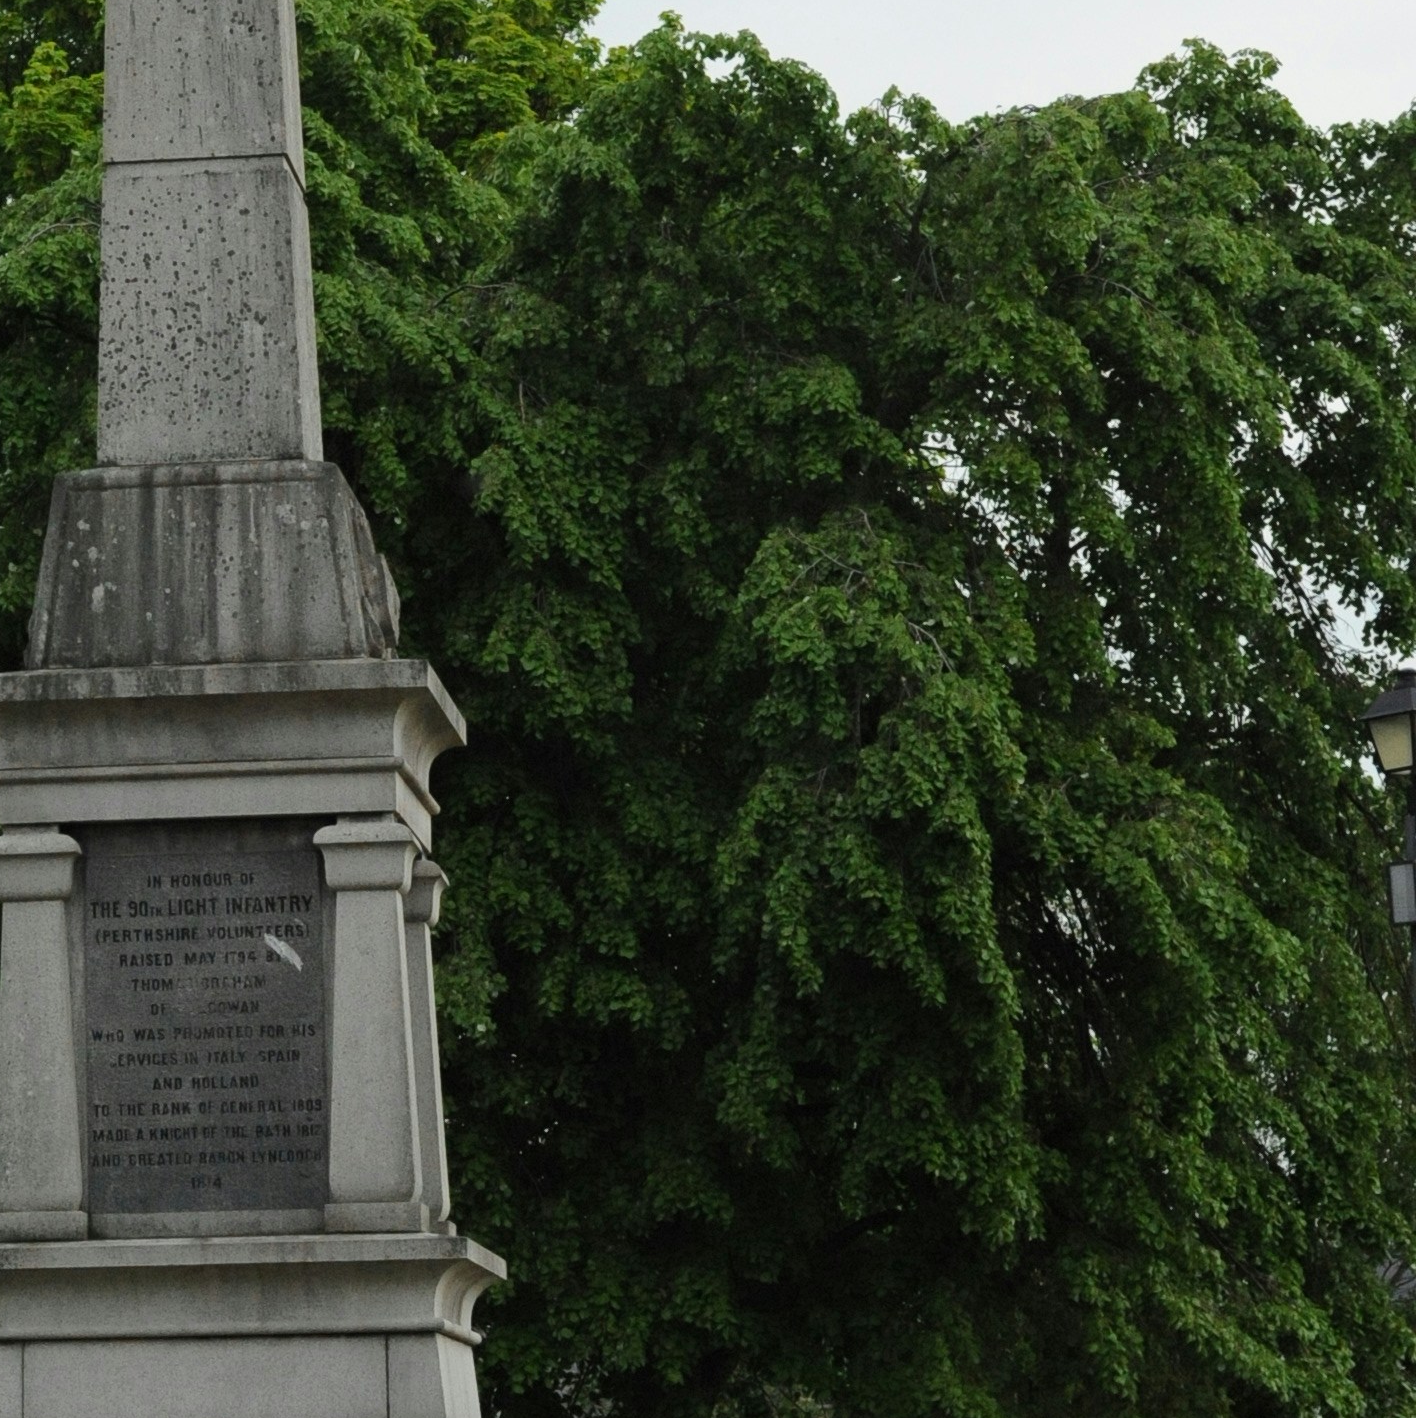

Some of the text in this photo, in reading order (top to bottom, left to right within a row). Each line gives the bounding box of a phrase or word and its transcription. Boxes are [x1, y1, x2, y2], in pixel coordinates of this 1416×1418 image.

[147, 873, 255, 888] IN HONOUR OF
[90, 901, 121, 918] THE
[168, 898, 219, 916] LIGHT
[226, 895, 312, 914] INFANTRY
[95, 928, 198, 944] (PERTHSHIRE
[120, 953, 173, 967] RAISED
[185, 952, 216, 964] MAY
[224, 951, 256, 963] 1794
[151, 1004, 167, 1015] OF
[91, 1029, 124, 1042] WHO
[133, 1028, 165, 1041] WAS
[260, 1025, 284, 1037] FOR
[292, 1024, 316, 1036] HIS
[185, 1052, 198, 1064] IN
[208, 1051, 246, 1063] ITALY
[258, 1049, 300, 1063] SPAIN
[152, 1075, 259, 1091] AND HOLLAND
[94, 1099, 322, 1117] TO THE RANK OF GENERAL 1809
[92, 1129, 130, 1142] MADE
[136, 1128, 144, 1140] A
[150, 1127, 197, 1140] KNIGHT
[203, 1127, 217, 1138] OF
[224, 1126, 248, 1138] THE
[256, 1125, 291, 1138] BATH
[92, 1154, 121, 1168] AND
